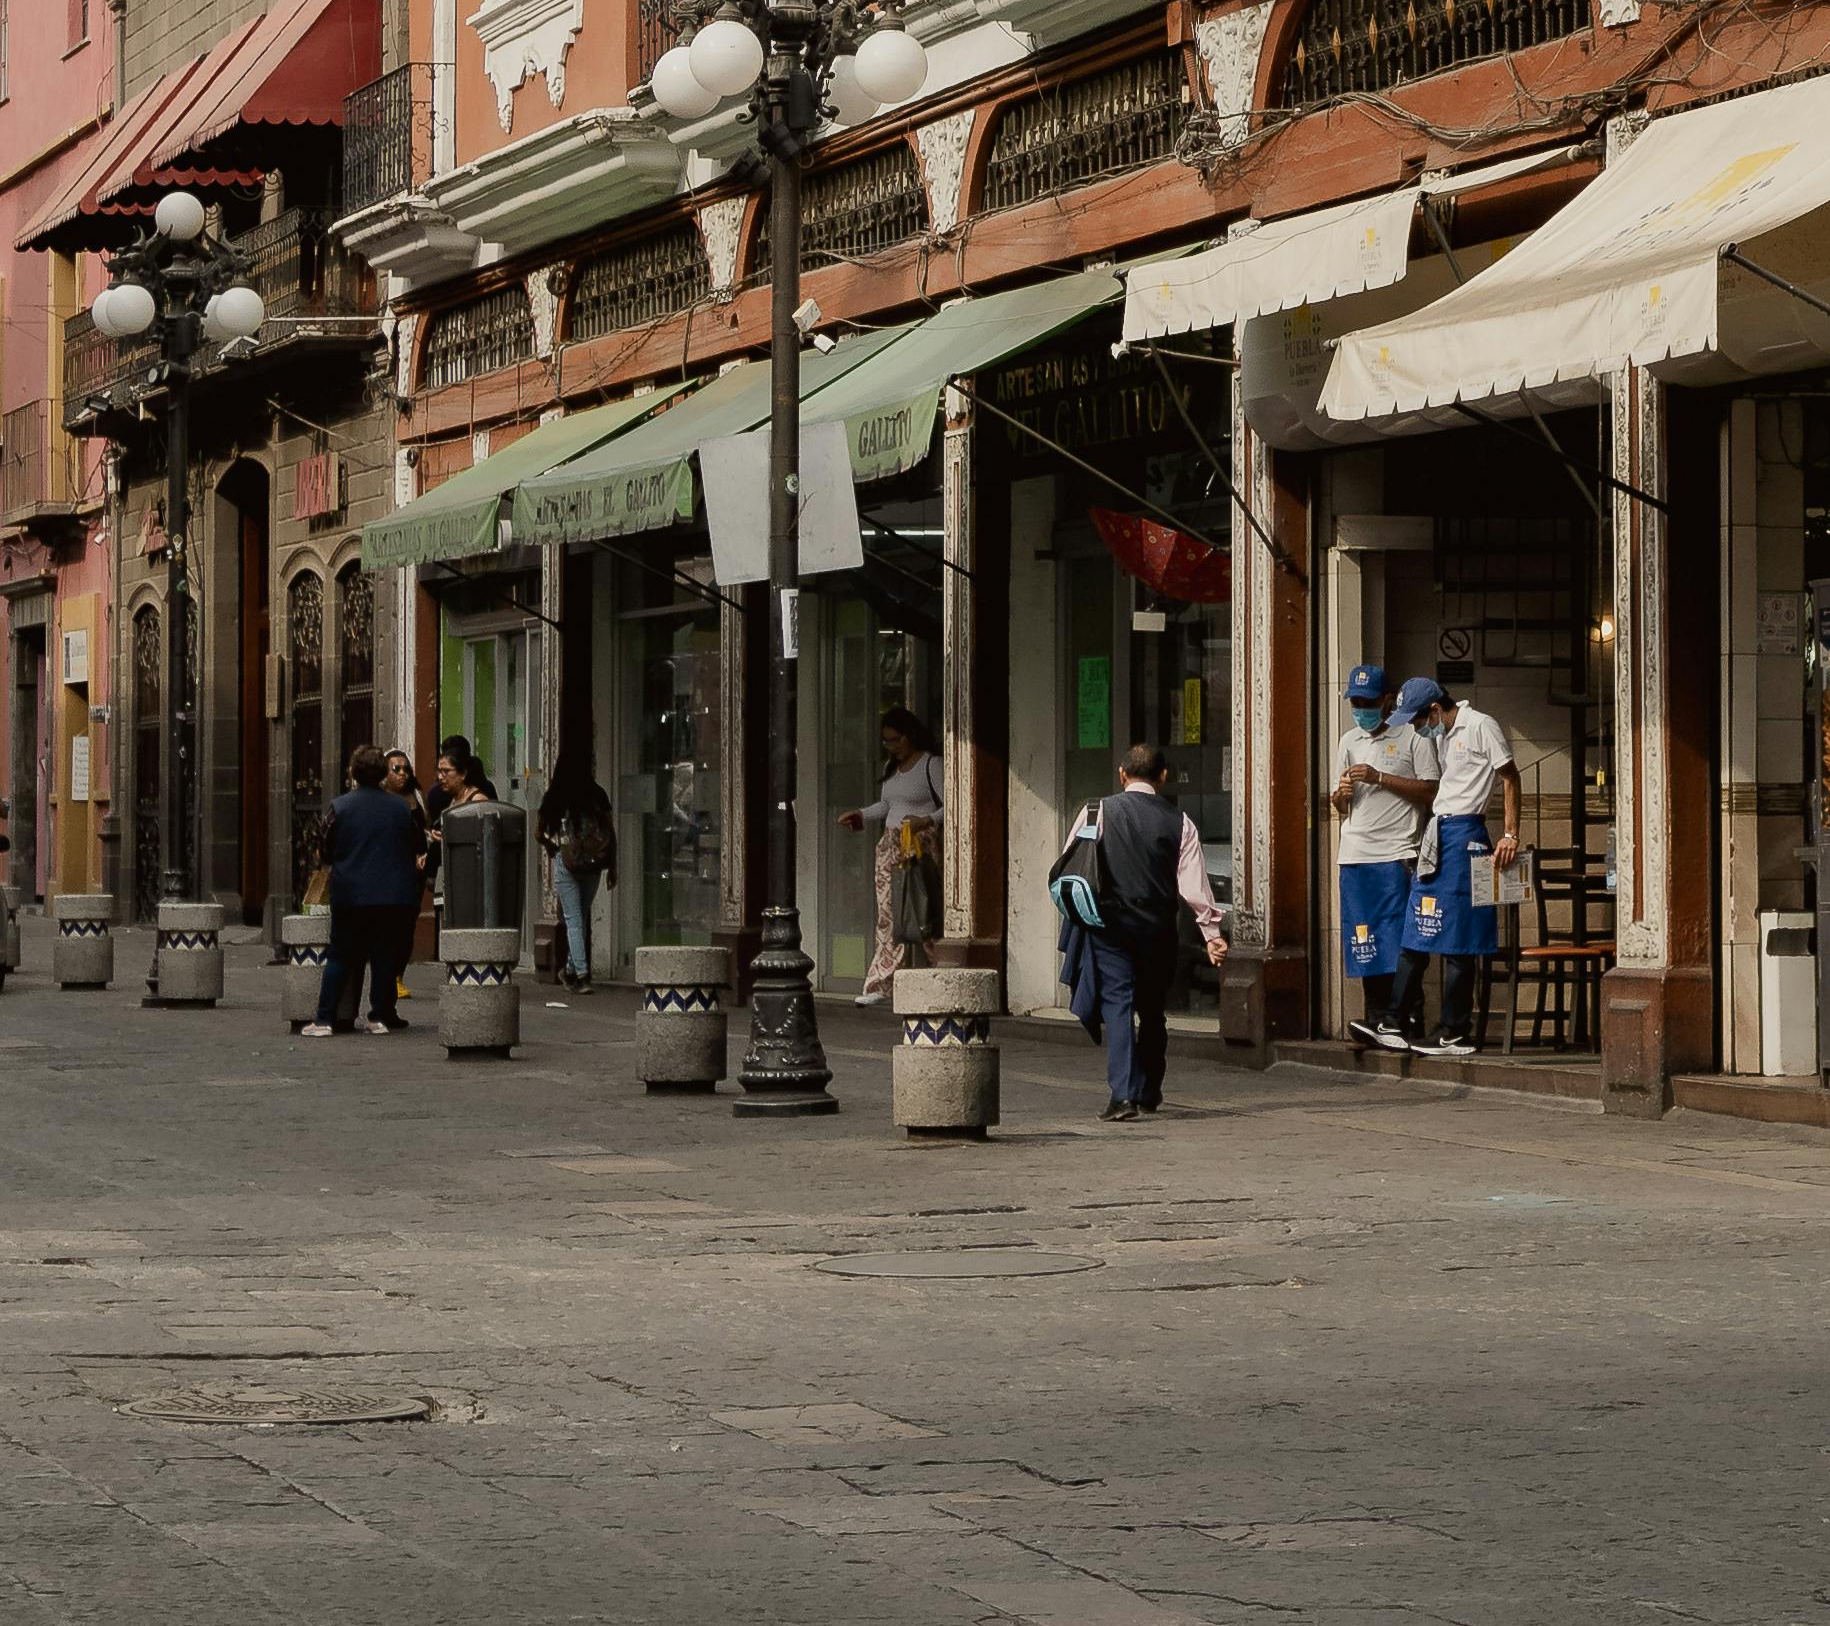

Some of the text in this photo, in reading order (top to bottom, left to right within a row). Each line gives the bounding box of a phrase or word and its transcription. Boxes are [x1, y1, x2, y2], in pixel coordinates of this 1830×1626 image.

[1284, 339, 1321, 360] PUEBLA
[1055, 380, 1166, 447] GALLITO
[858, 406, 912, 459] GALLITO
[1414, 917, 1442, 928] PUEBLA
